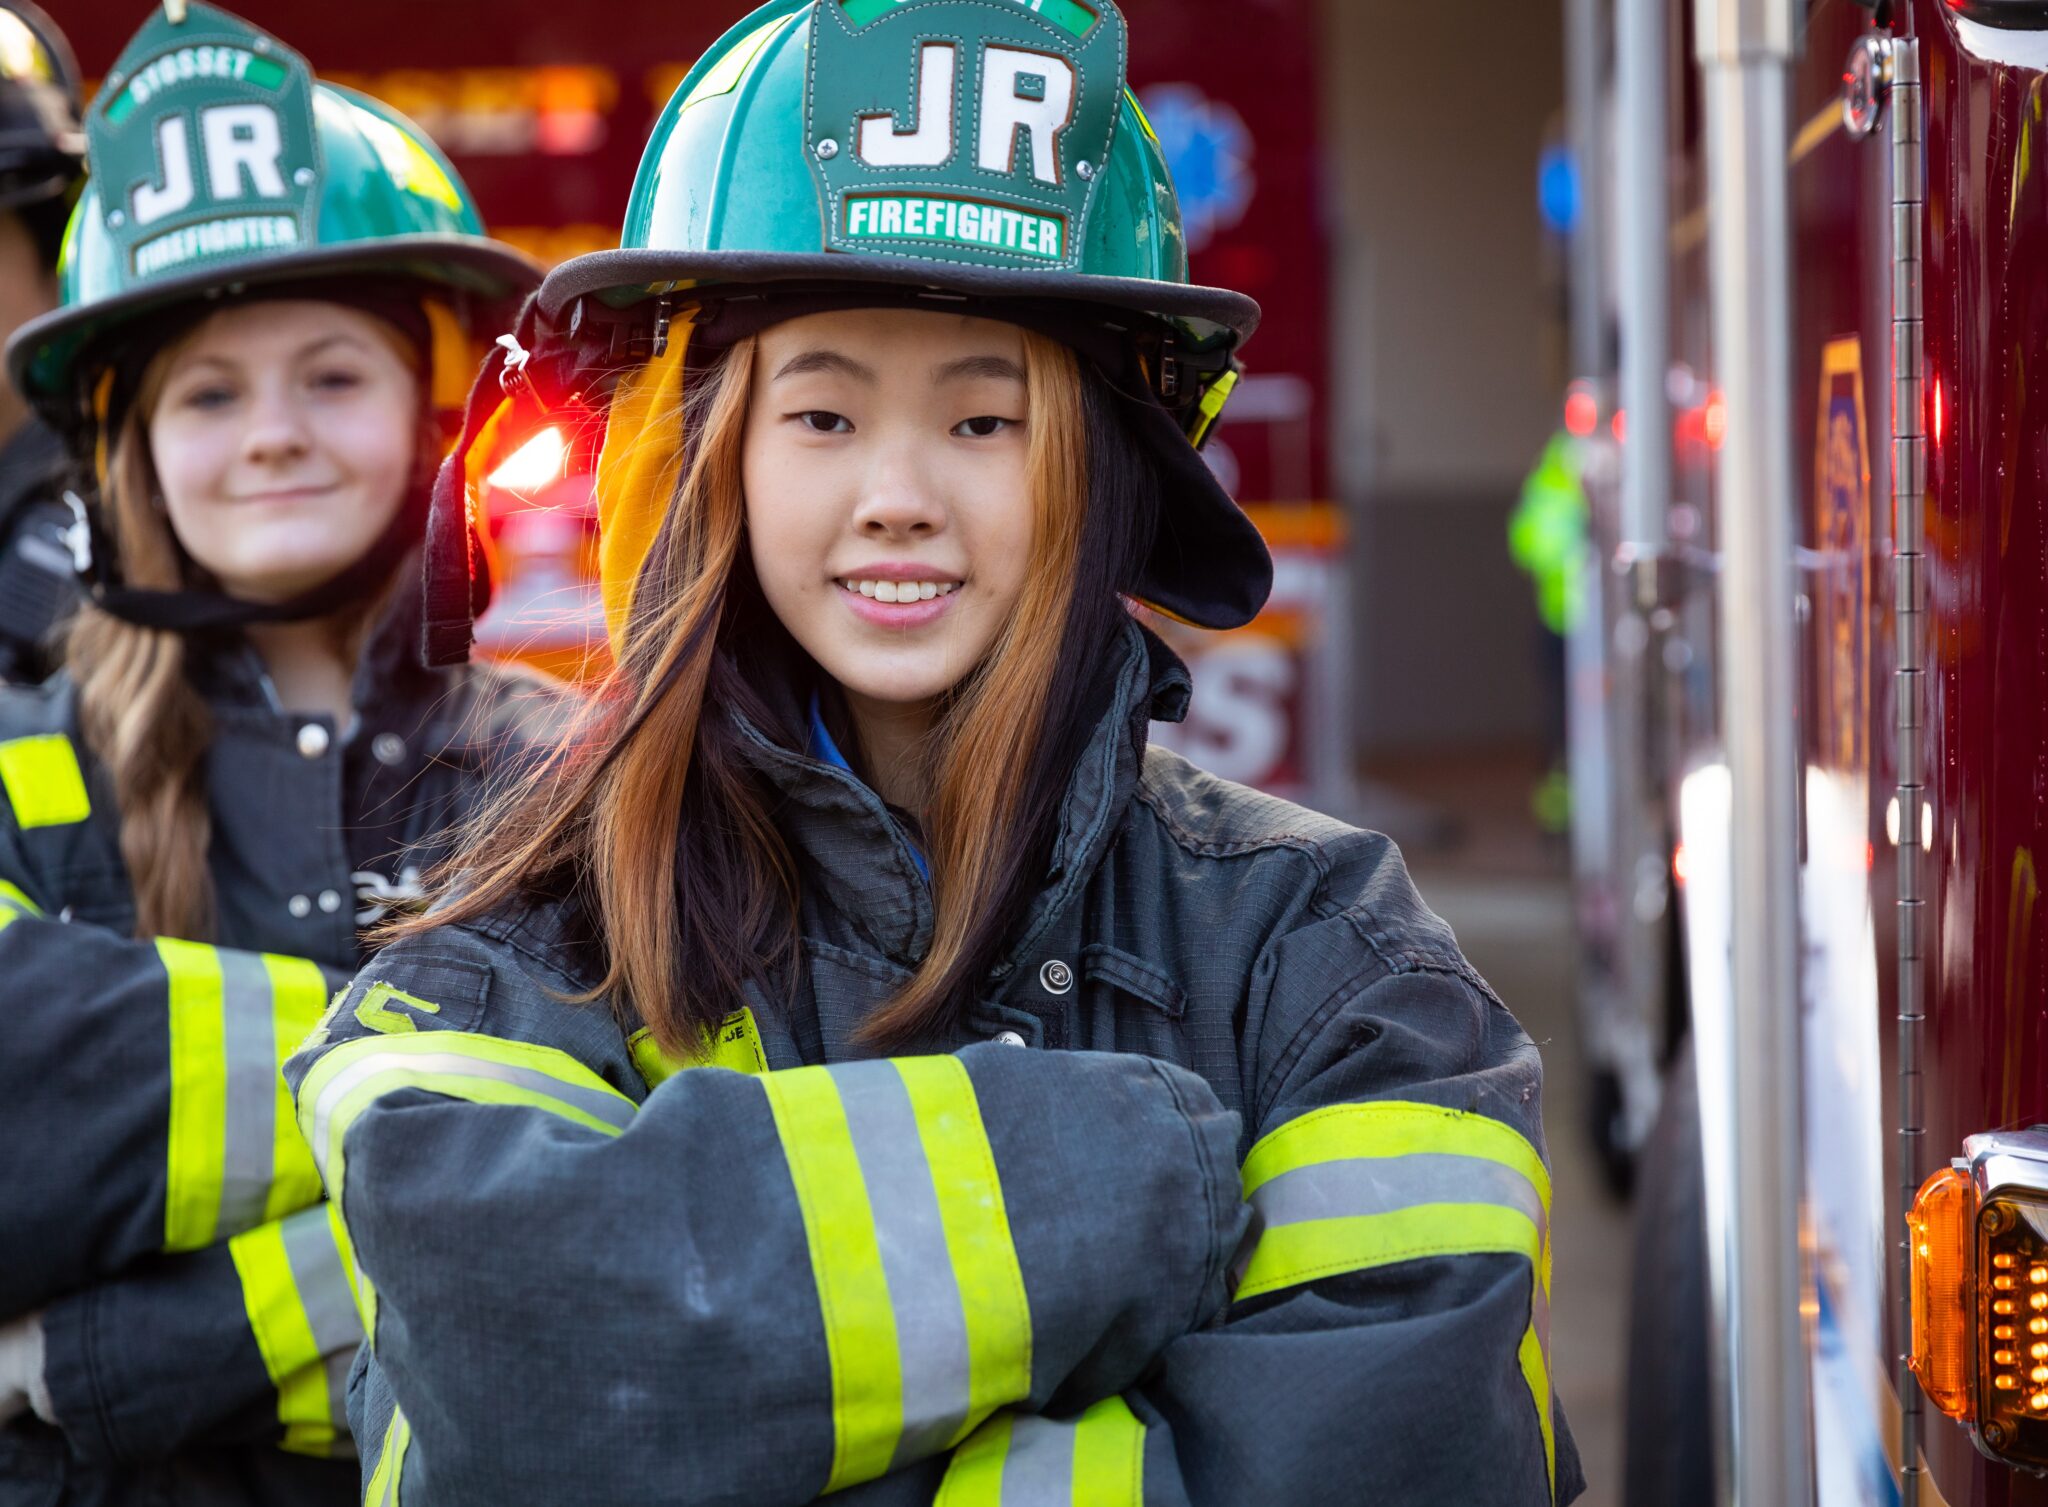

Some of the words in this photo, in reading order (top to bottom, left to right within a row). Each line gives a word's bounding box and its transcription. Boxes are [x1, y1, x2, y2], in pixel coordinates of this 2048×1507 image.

[859, 44, 1073, 186] JR
[133, 103, 287, 226] JR
[136, 215, 298, 277] FIREFIGHTER
[849, 199, 1058, 256] FIREFIGHTER
